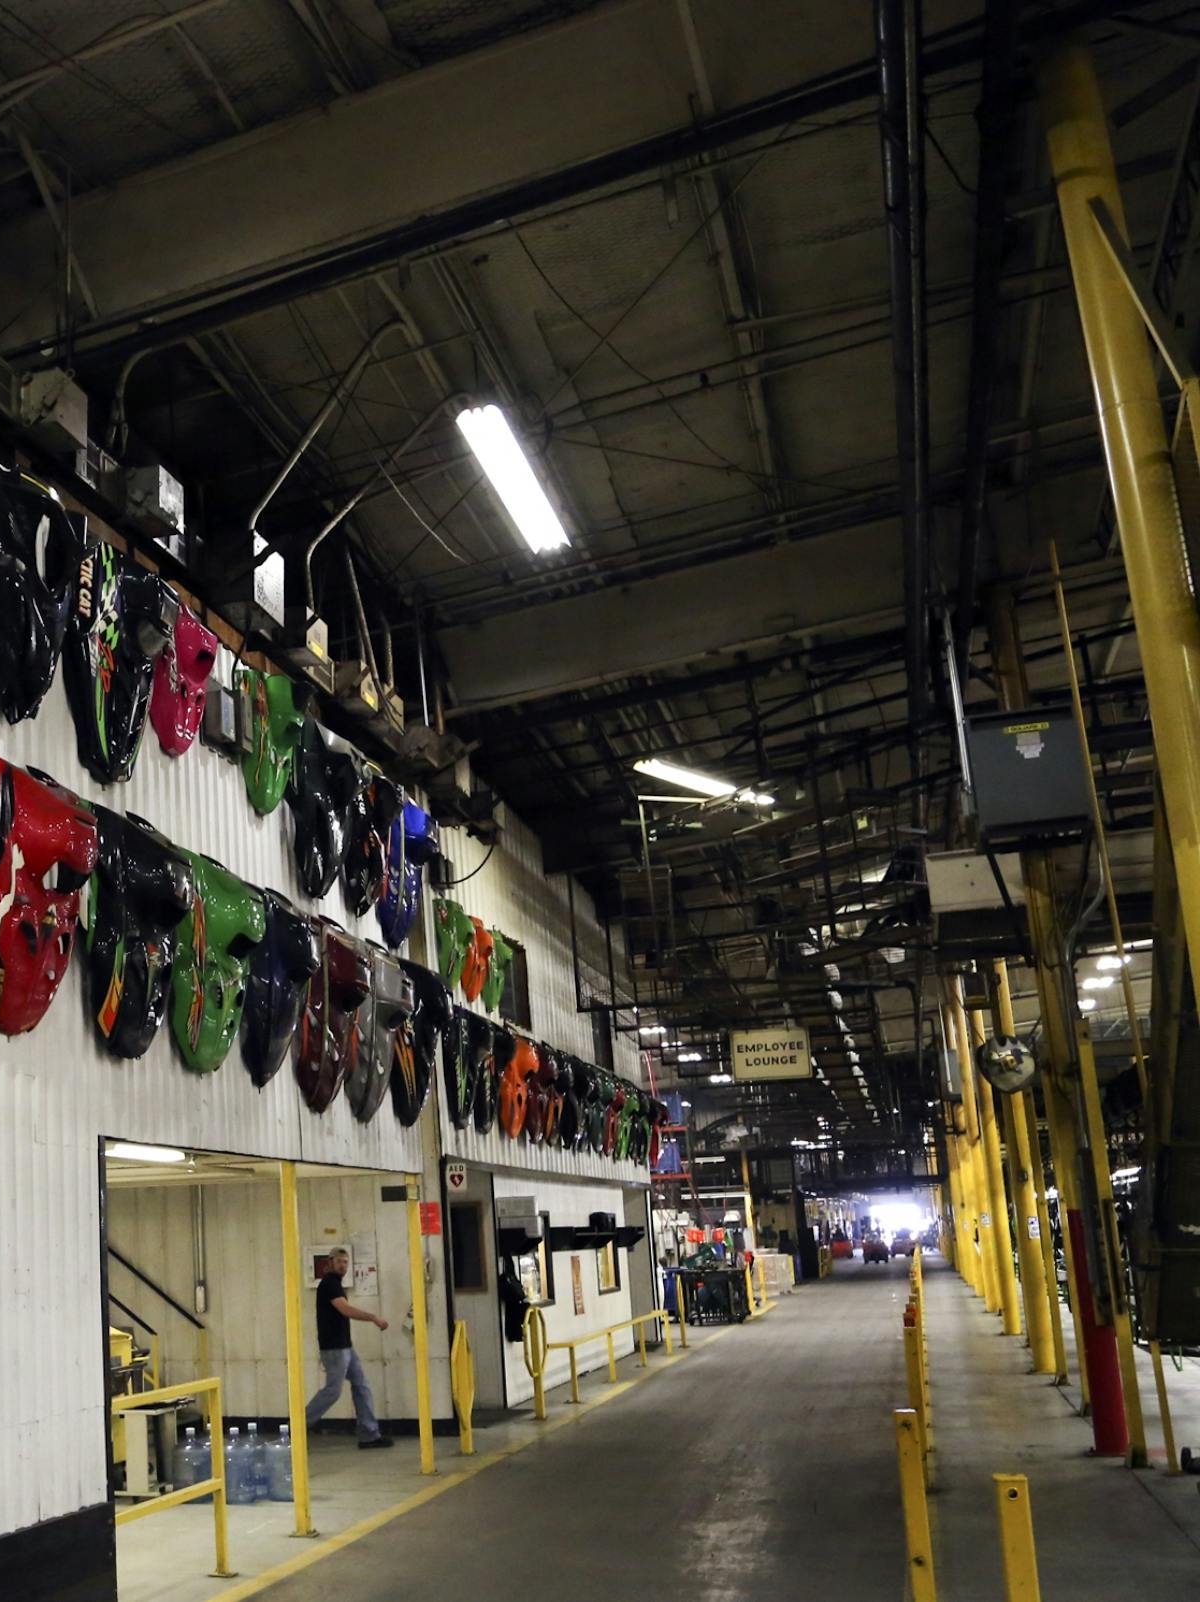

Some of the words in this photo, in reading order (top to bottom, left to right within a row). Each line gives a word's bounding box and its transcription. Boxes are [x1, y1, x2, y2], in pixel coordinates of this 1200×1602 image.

[78, 588, 92, 618] CAT
[736, 1041, 804, 1053] EMPLOYEE
[745, 1055, 797, 1067] LOUNGE
